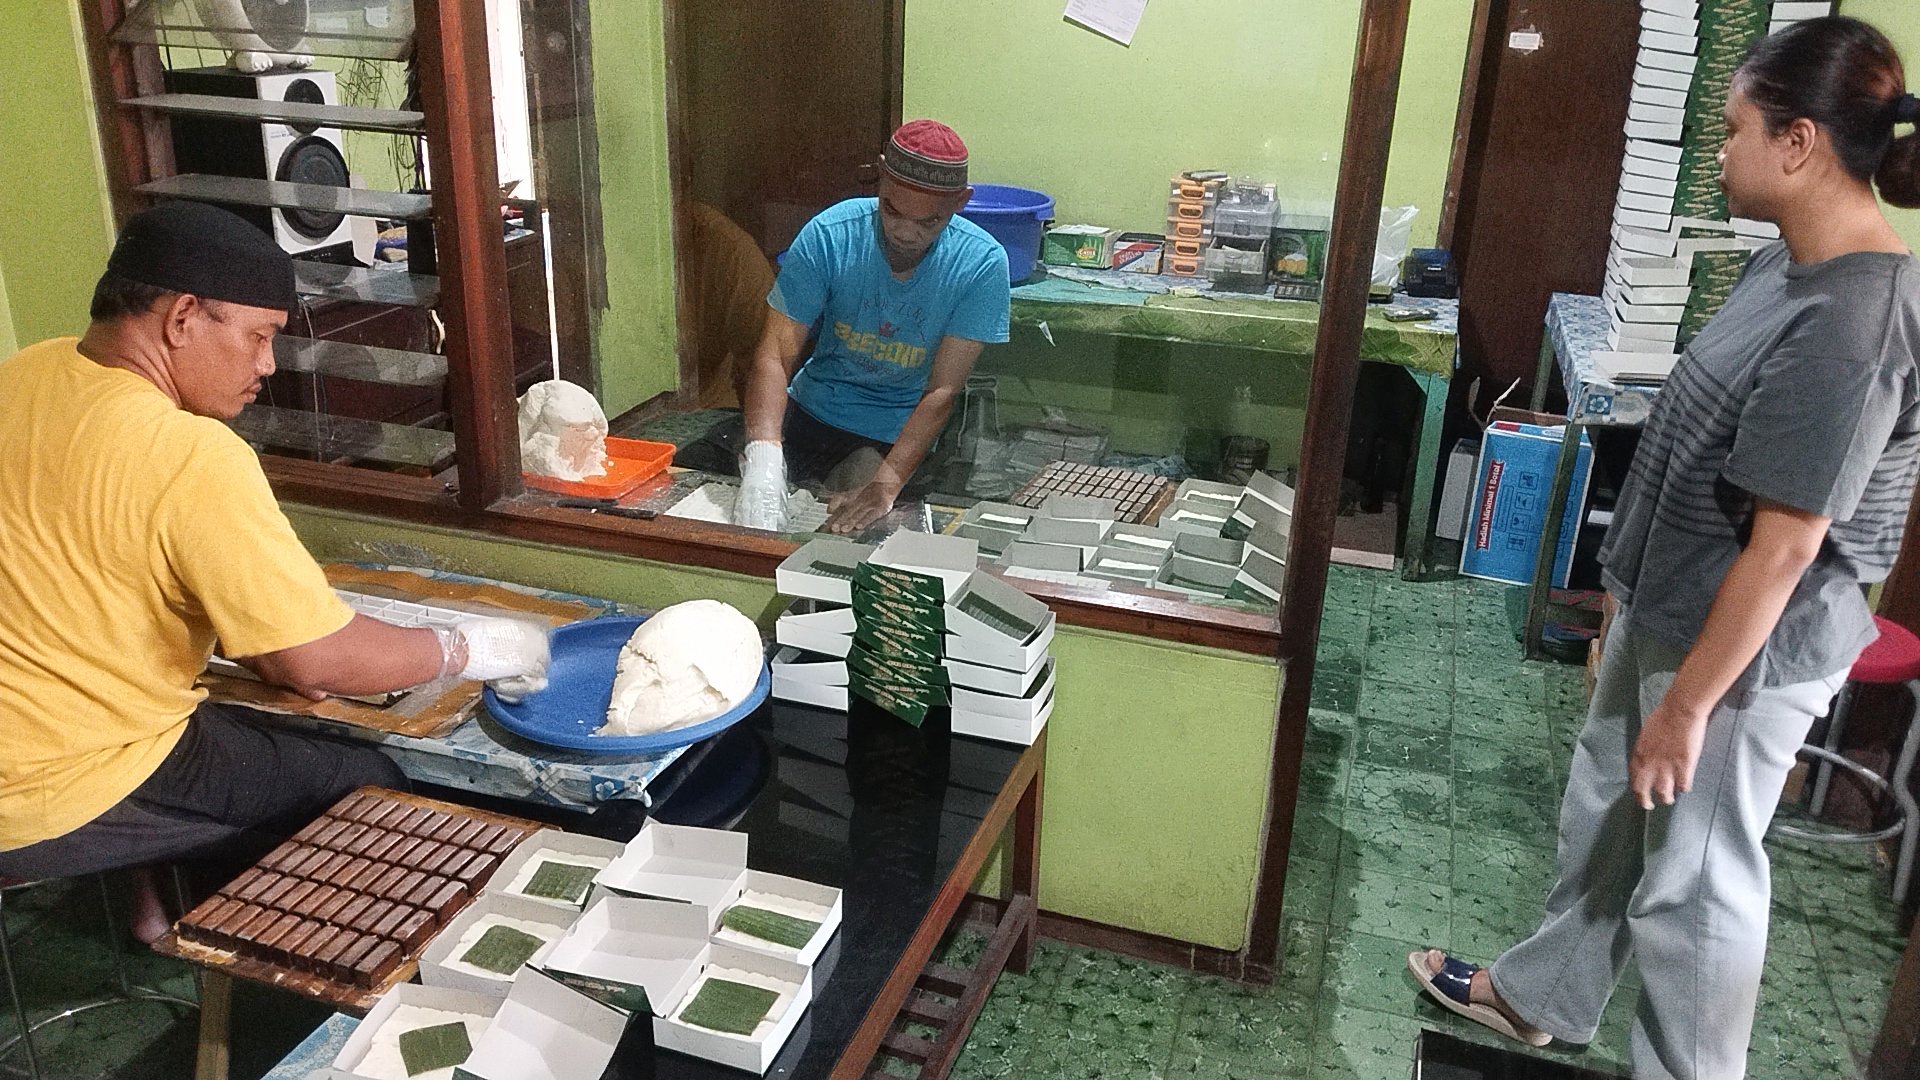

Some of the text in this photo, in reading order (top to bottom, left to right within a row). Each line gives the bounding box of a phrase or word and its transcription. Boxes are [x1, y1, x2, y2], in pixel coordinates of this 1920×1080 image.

[1489, 464, 1501, 485] Botol
[1483, 491, 1494, 521] Minimal
[1479, 522, 1489, 547] Hadiah
